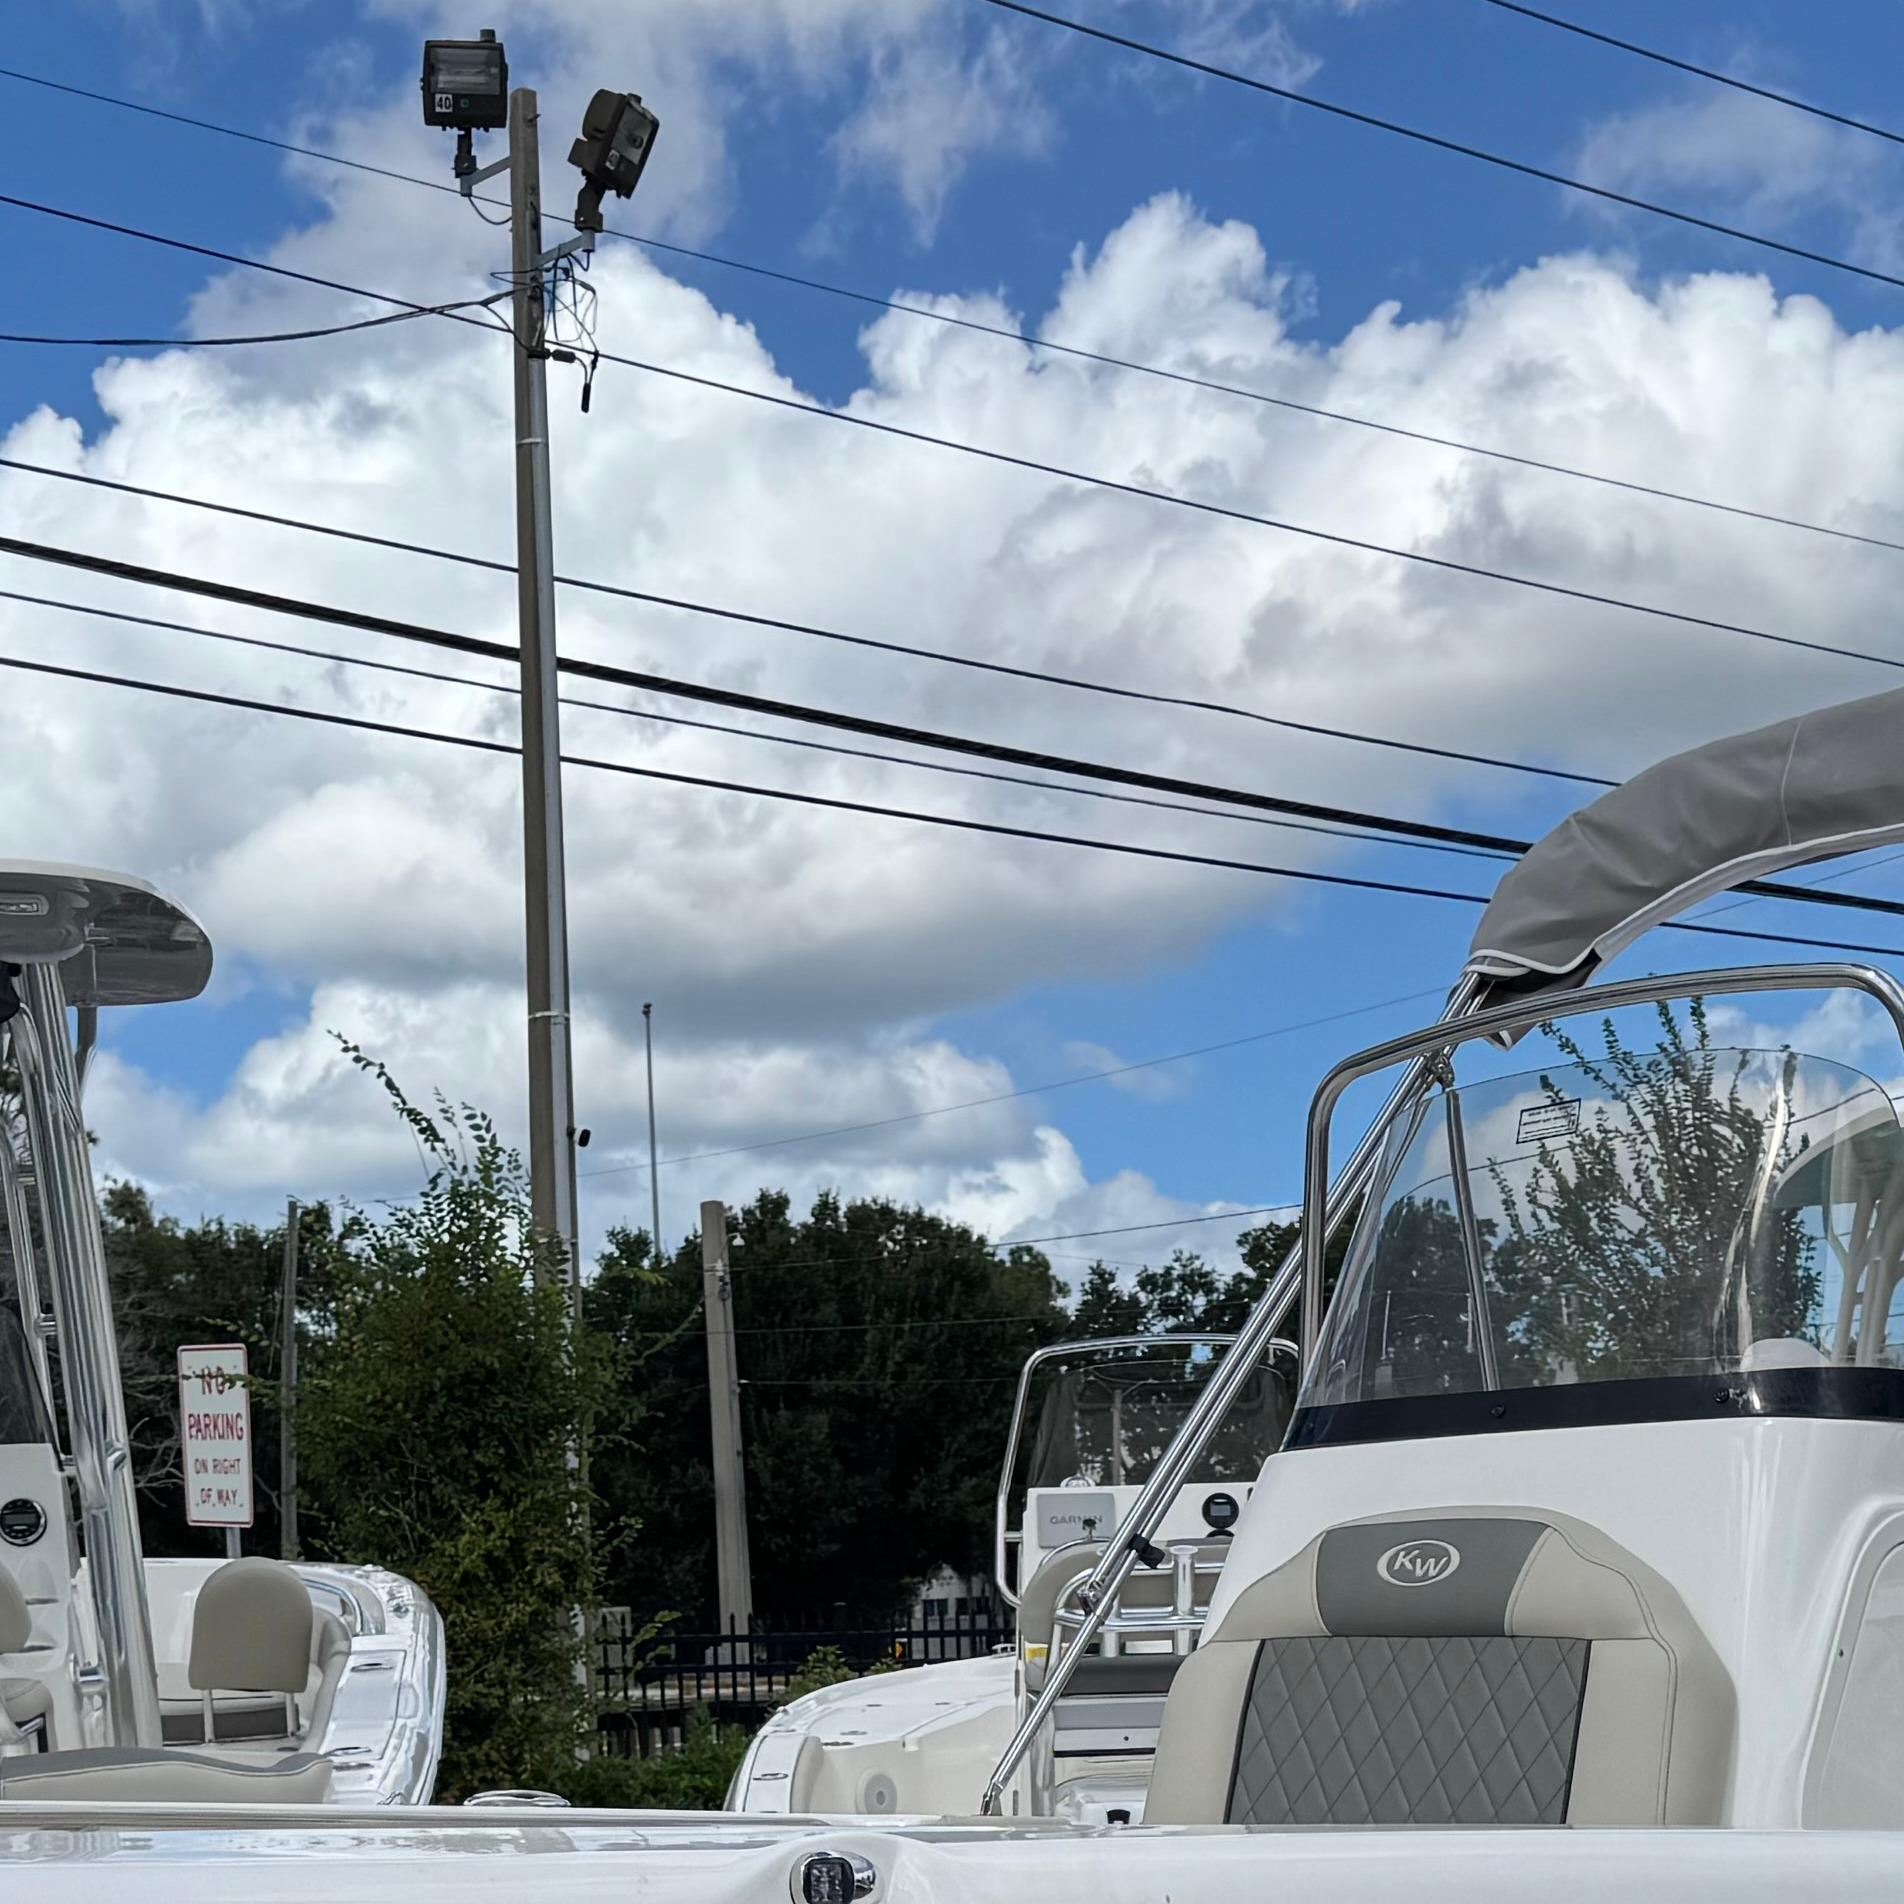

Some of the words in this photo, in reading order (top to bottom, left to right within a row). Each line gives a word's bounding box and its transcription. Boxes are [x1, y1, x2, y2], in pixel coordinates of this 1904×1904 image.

[201, 1366, 225, 1395] NO
[188, 1412, 244, 1440] PARKING
[195, 1458, 209, 1474] ON
[212, 1458, 240, 1474] RIGHT
[200, 1488, 212, 1504] OF
[216, 1488, 238, 1505] WAY
